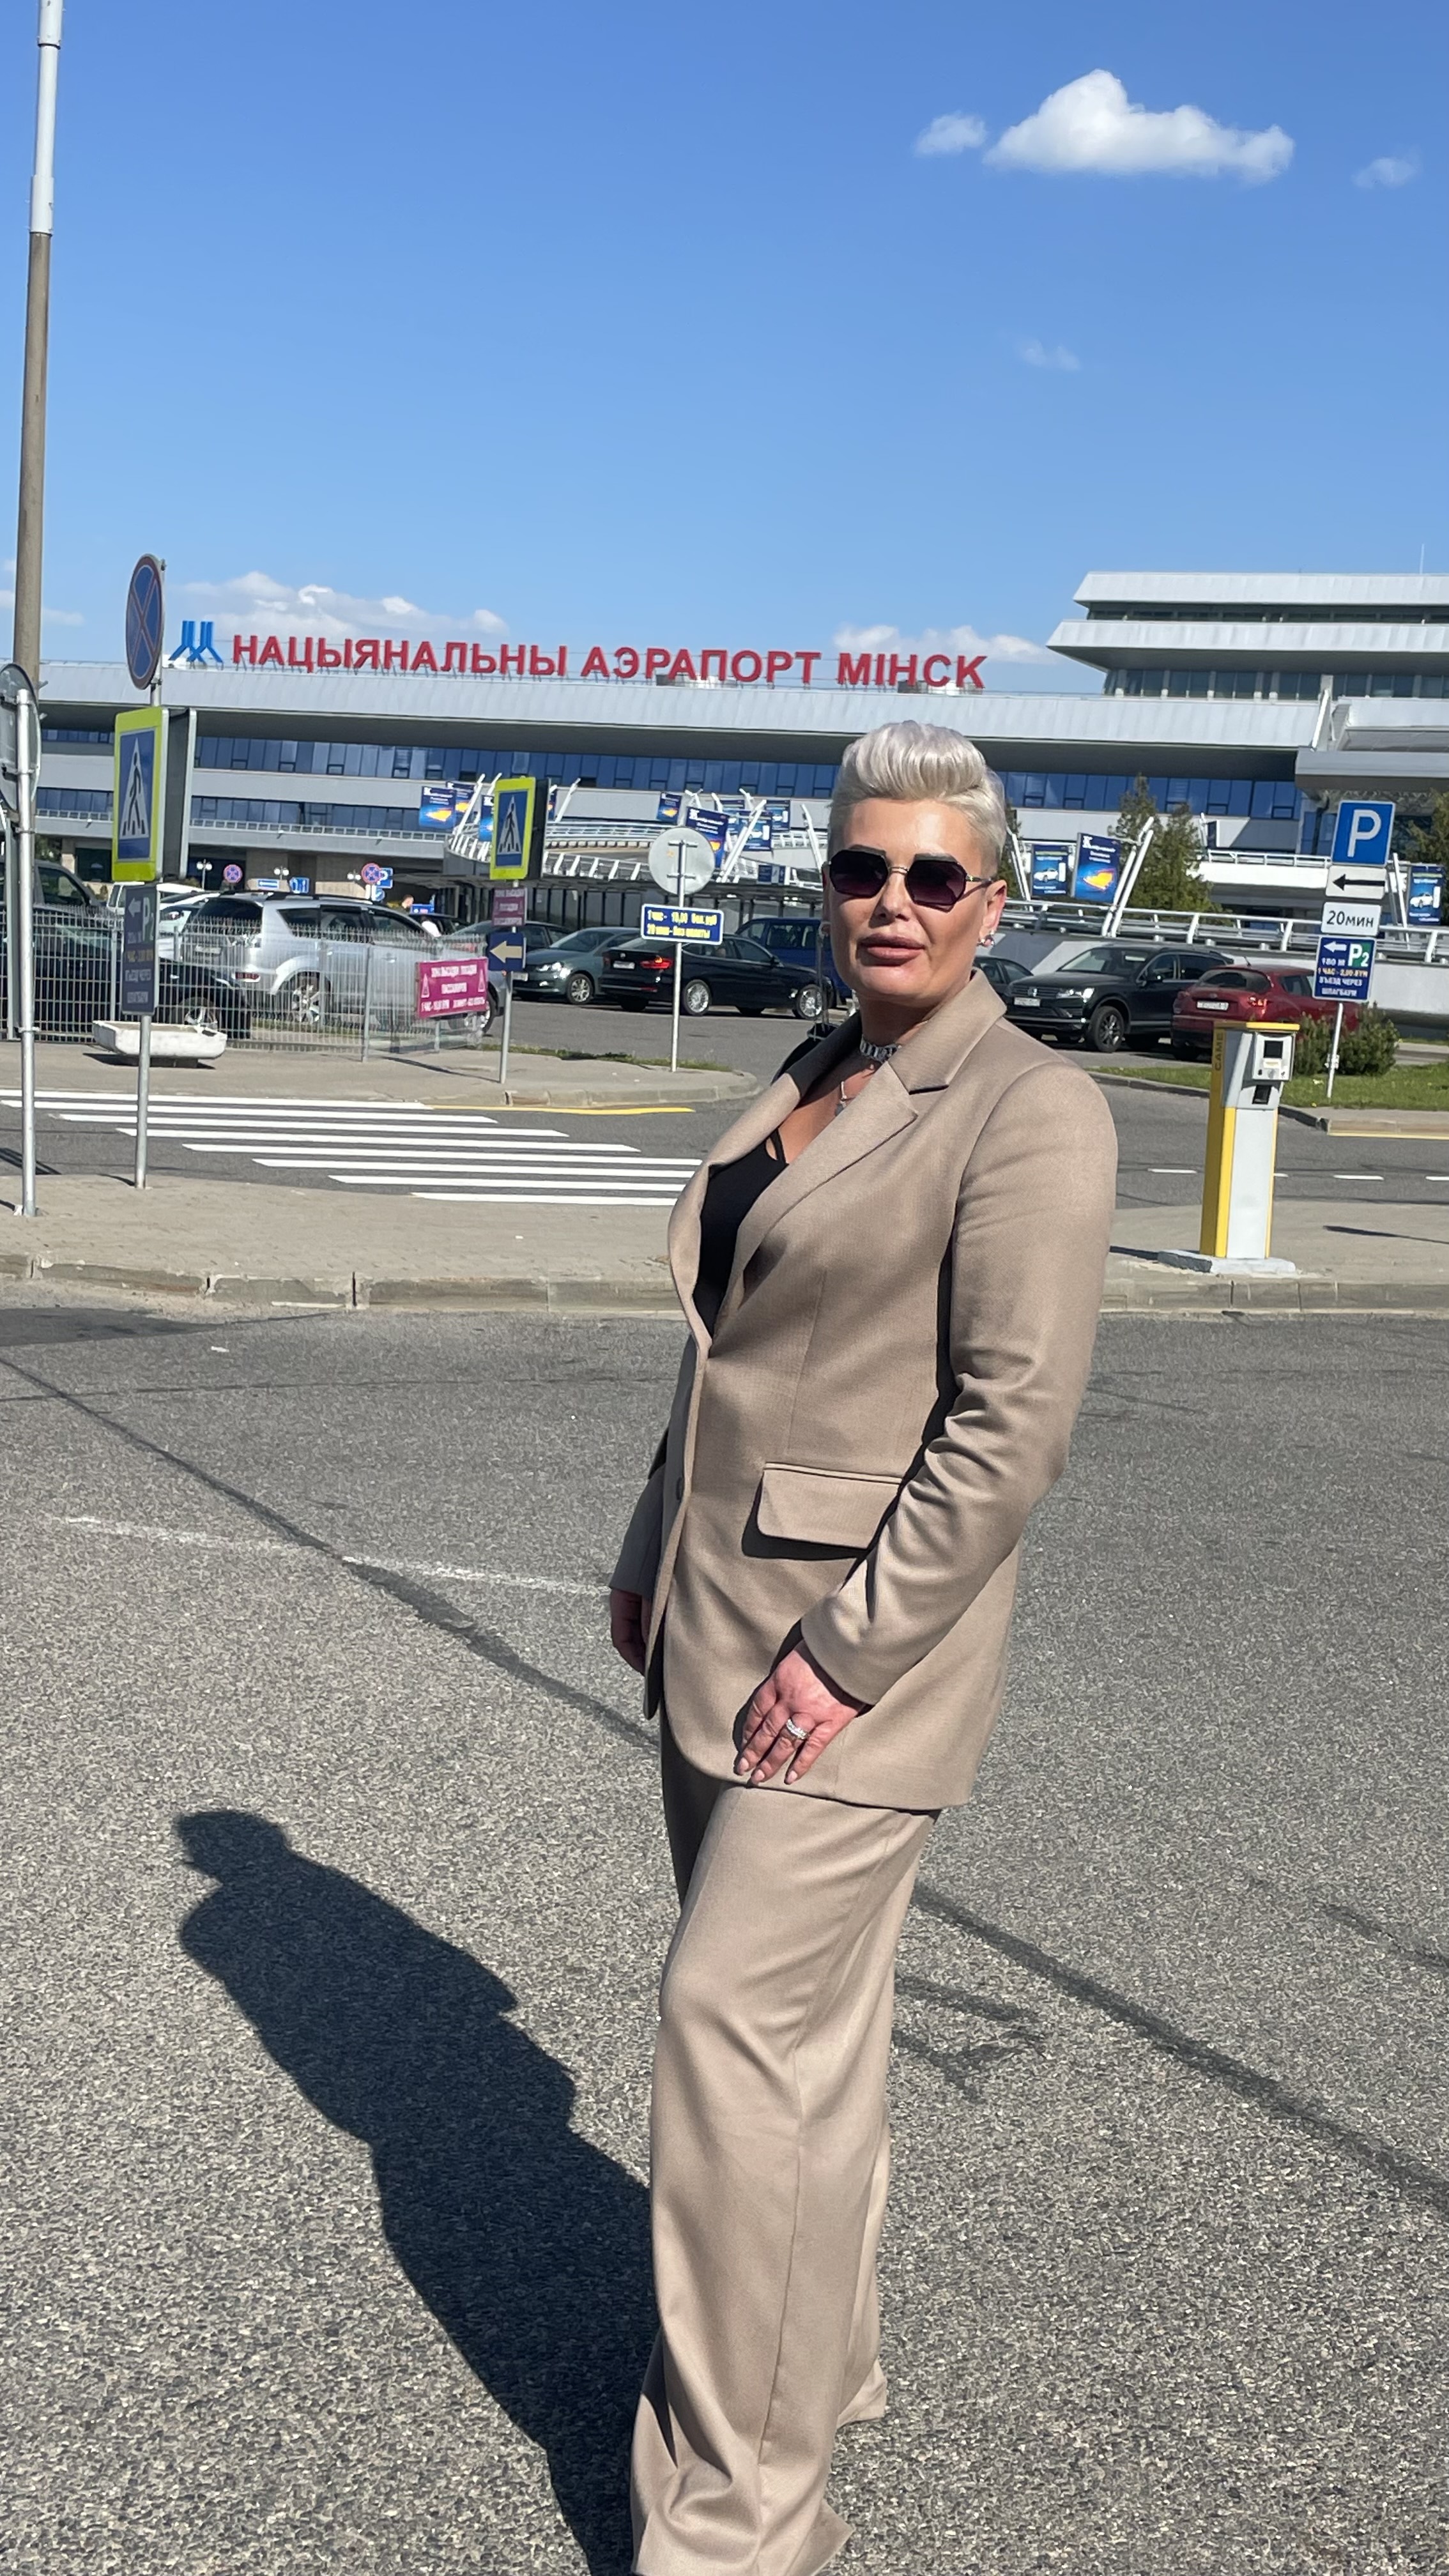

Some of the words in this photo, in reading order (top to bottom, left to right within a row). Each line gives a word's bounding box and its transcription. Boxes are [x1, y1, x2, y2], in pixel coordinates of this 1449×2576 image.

[233, 634, 568, 677] НАЦЫЯНАЛЬНЫ
[580, 645, 822, 684] АЭРАПОРТ
[837, 652, 988, 689] МІНСК
[1347, 809, 1381, 857] P
[1215, 1032, 1223, 1071] CAME
